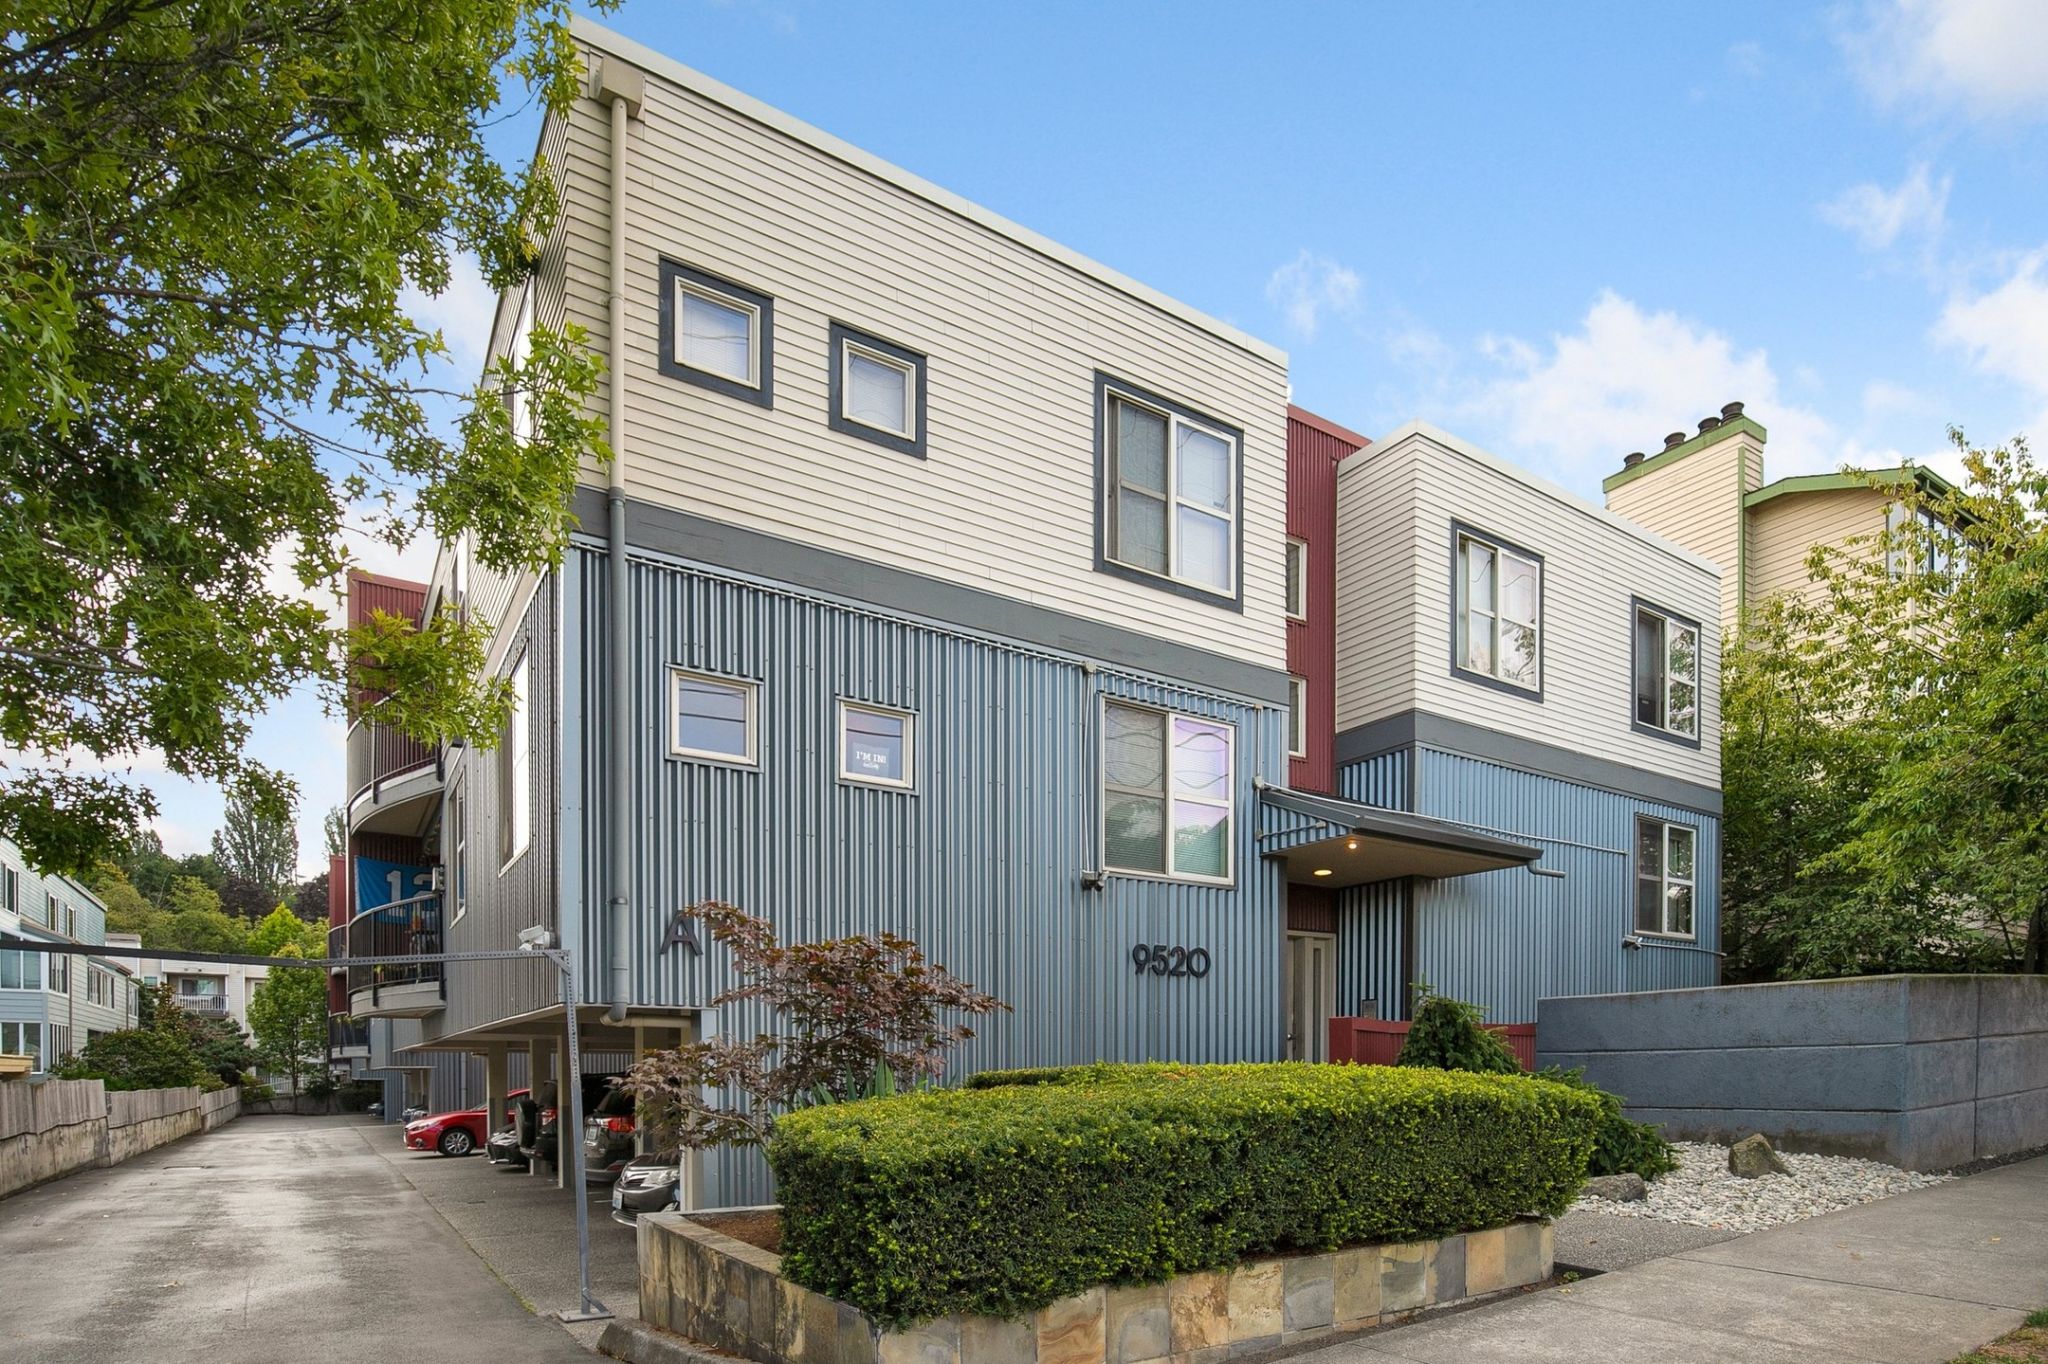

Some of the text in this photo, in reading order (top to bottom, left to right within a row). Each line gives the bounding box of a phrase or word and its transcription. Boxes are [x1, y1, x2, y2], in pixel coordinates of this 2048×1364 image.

[856, 751, 871, 761] I'M
[660, 910, 704, 956] A
[1132, 943, 1211, 978] 9520
